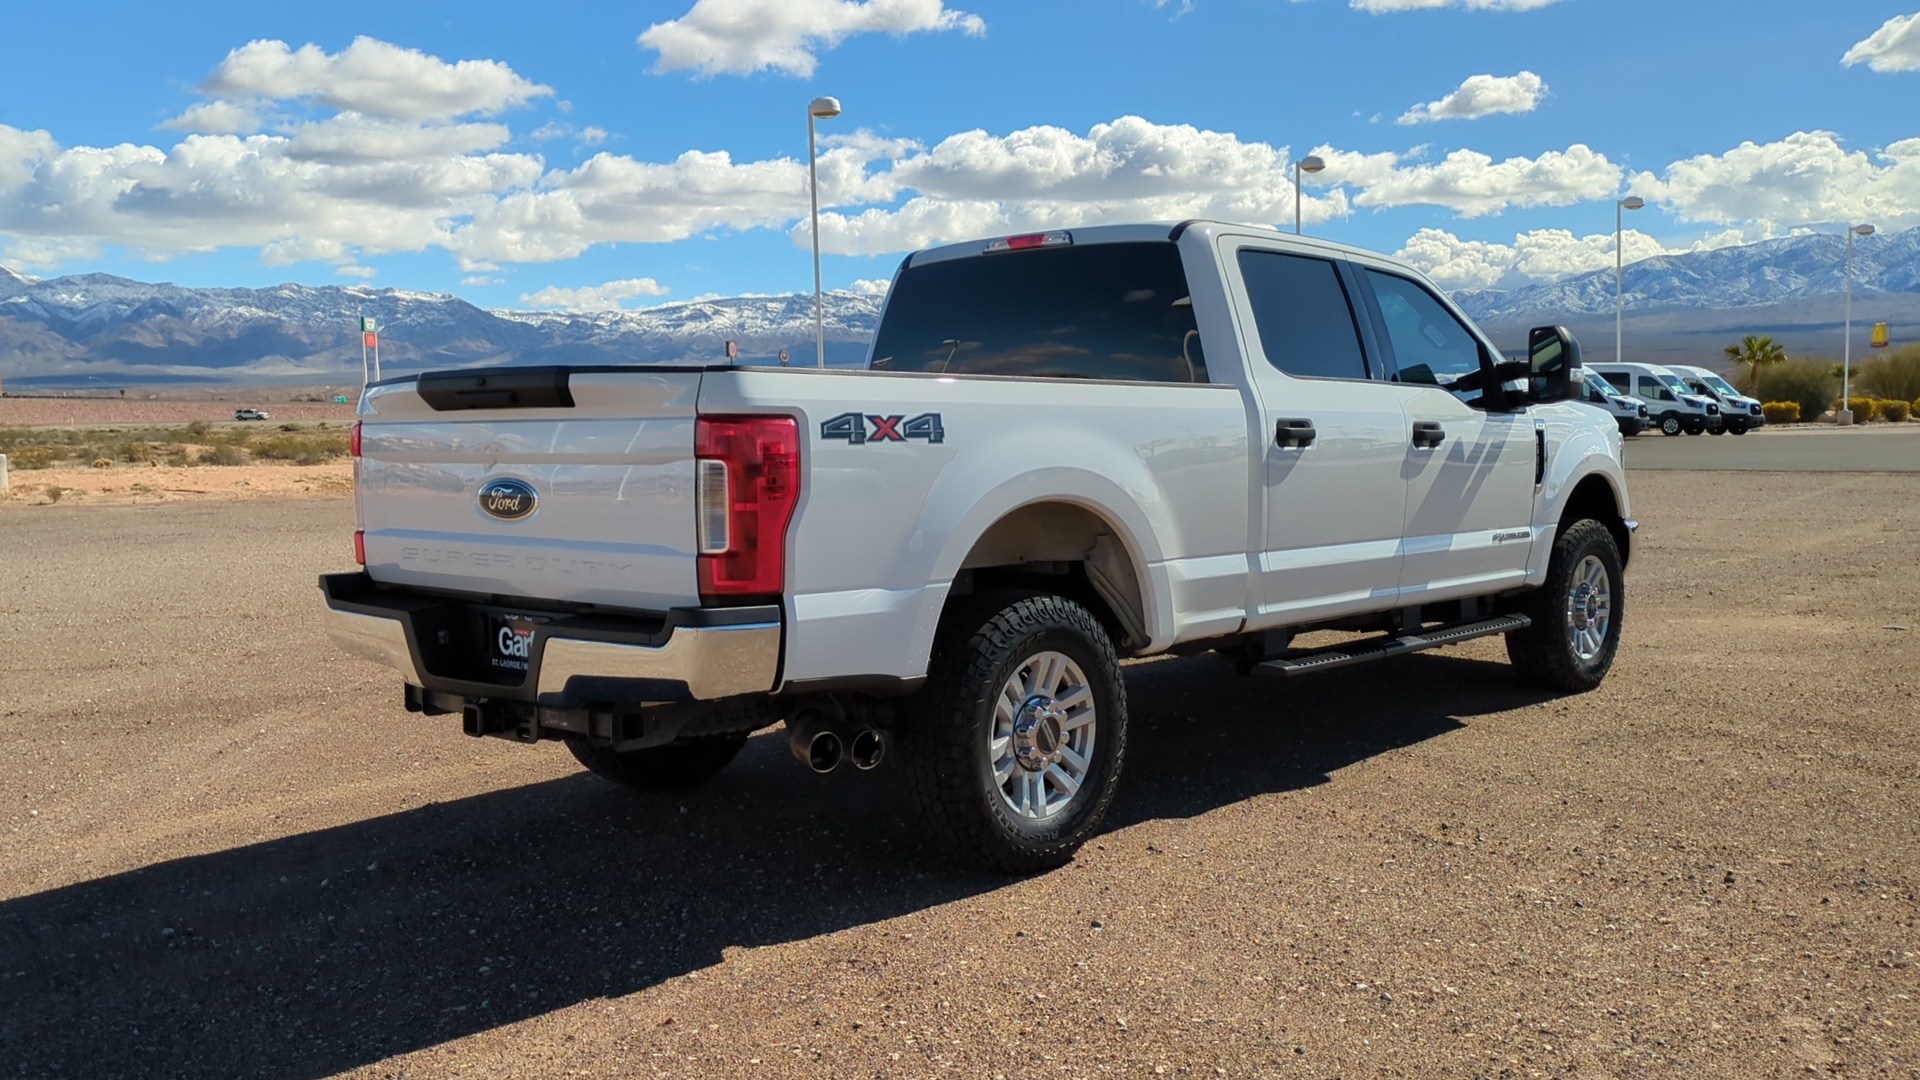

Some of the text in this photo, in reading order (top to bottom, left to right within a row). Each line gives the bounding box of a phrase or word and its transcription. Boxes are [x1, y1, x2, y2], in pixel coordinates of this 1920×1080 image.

[488, 486, 521, 511] Ford
[402, 545, 632, 575] SUPER DUTY
[987, 790, 1059, 841] ALL-TERRAIN
